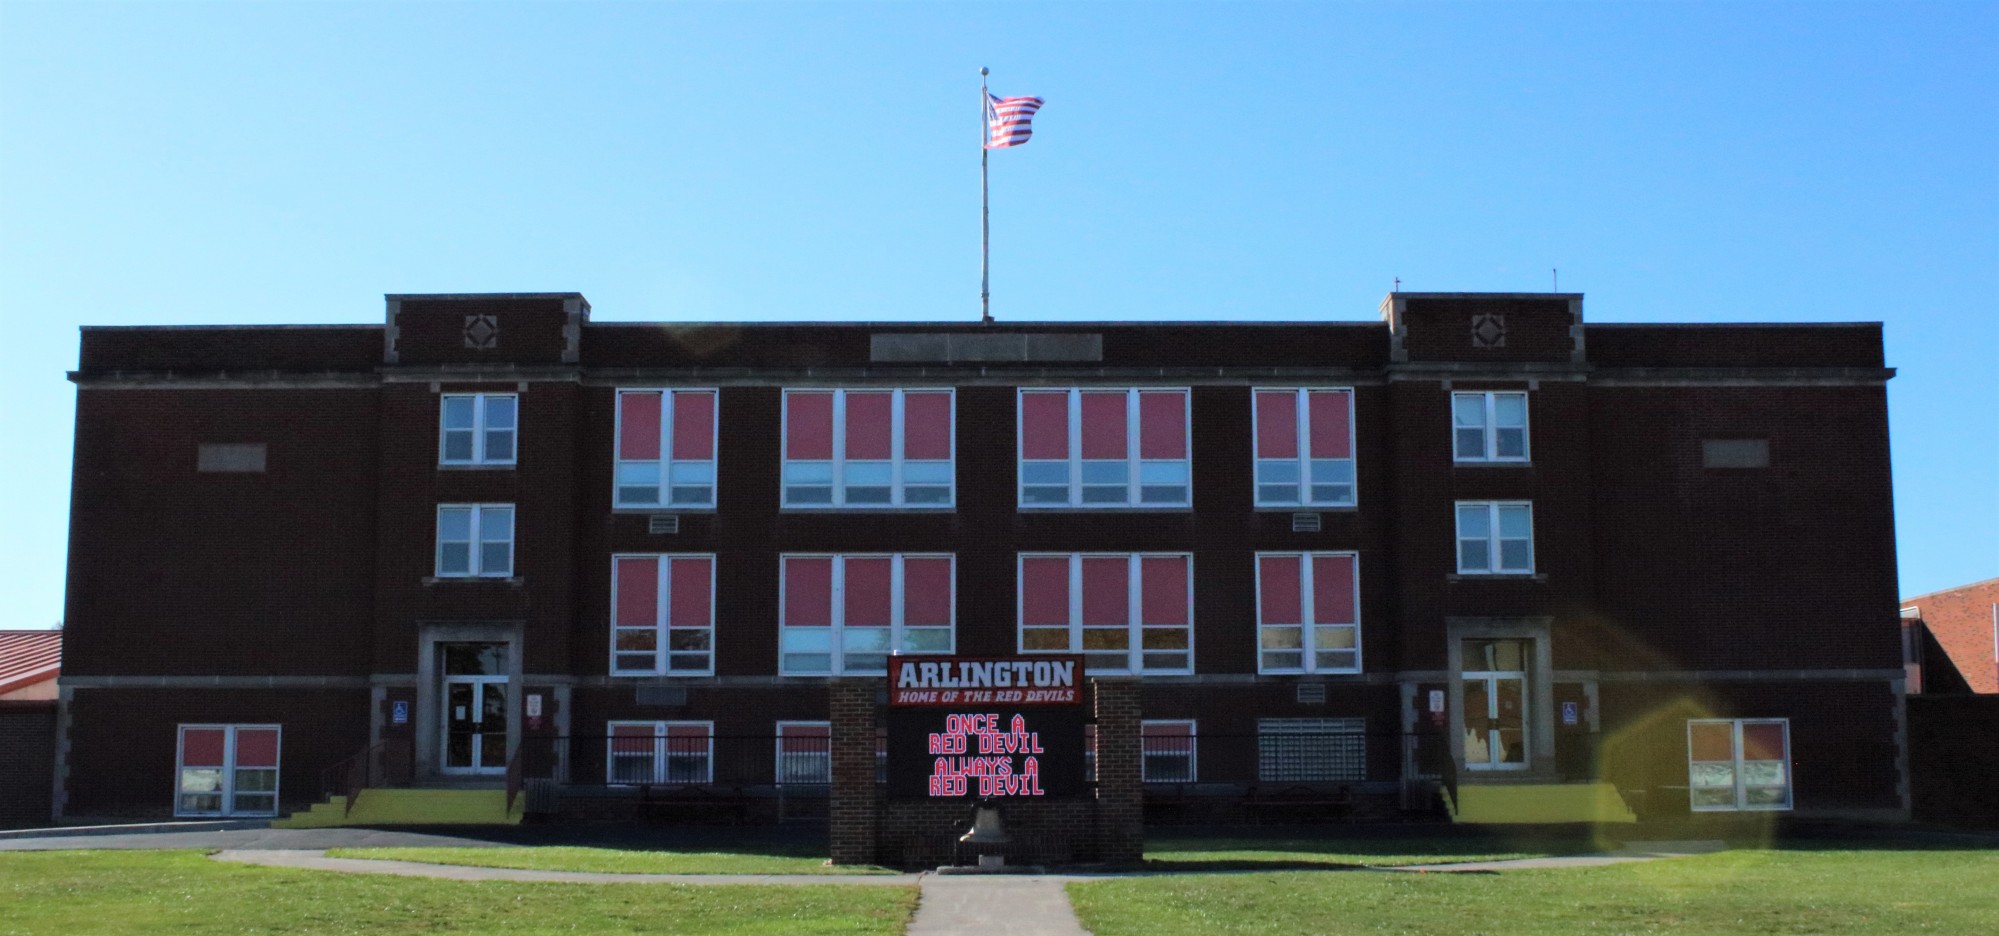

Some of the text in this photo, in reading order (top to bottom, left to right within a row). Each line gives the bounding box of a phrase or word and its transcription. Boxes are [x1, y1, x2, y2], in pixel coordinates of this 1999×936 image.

[898, 661, 1075, 688] ARLINGTON
[898, 690, 1074, 703] HOME OF THE RED DEVILS
[946, 713, 1025, 734] ONCE A
[929, 733, 1044, 754] RED DEVIL
[935, 756, 1038, 776] ALWAYS A
[929, 775, 1044, 796] RED DEVIL
